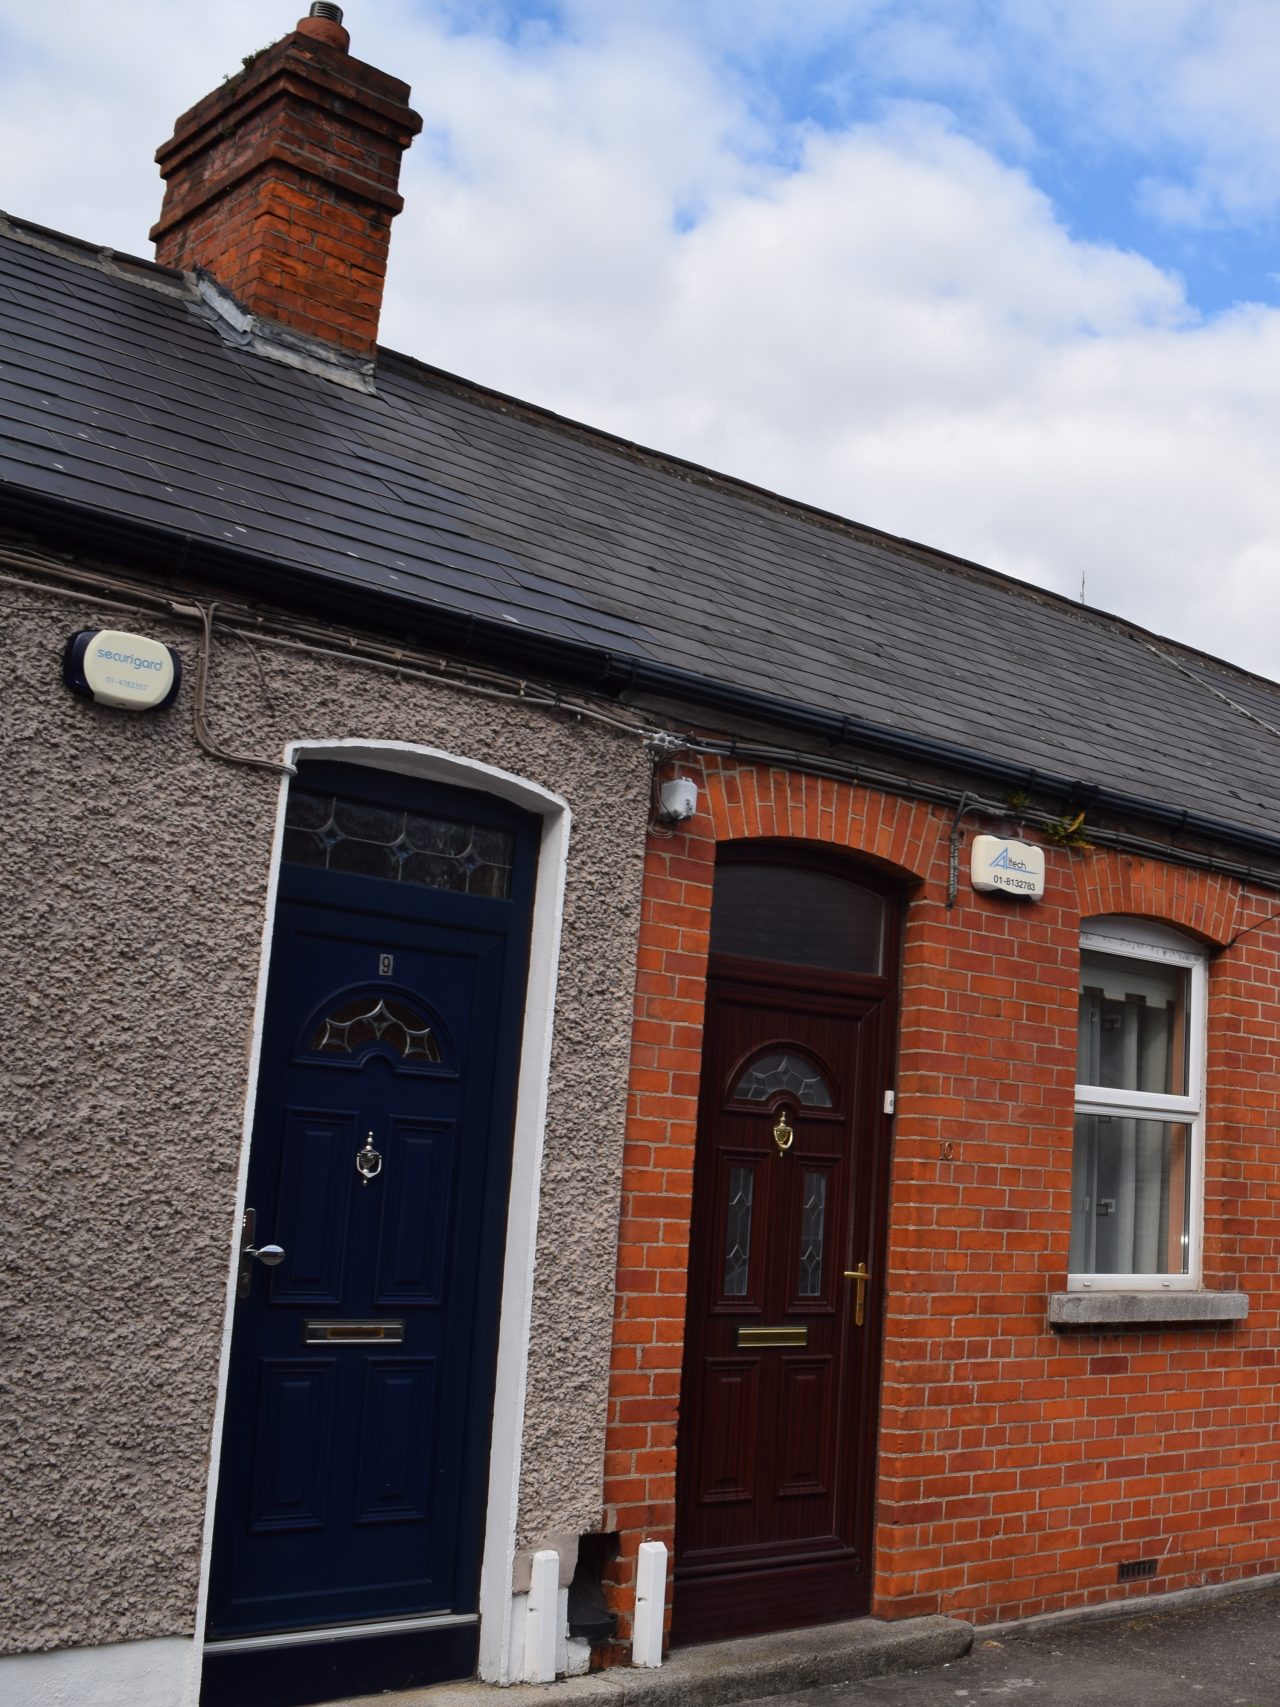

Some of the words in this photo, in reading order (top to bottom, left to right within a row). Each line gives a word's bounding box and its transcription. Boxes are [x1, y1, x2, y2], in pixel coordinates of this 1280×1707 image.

[97, 649, 163, 671] securigard
[993, 874, 1036, 892] 01-8132783
[382, 956, 391, 974] 9
